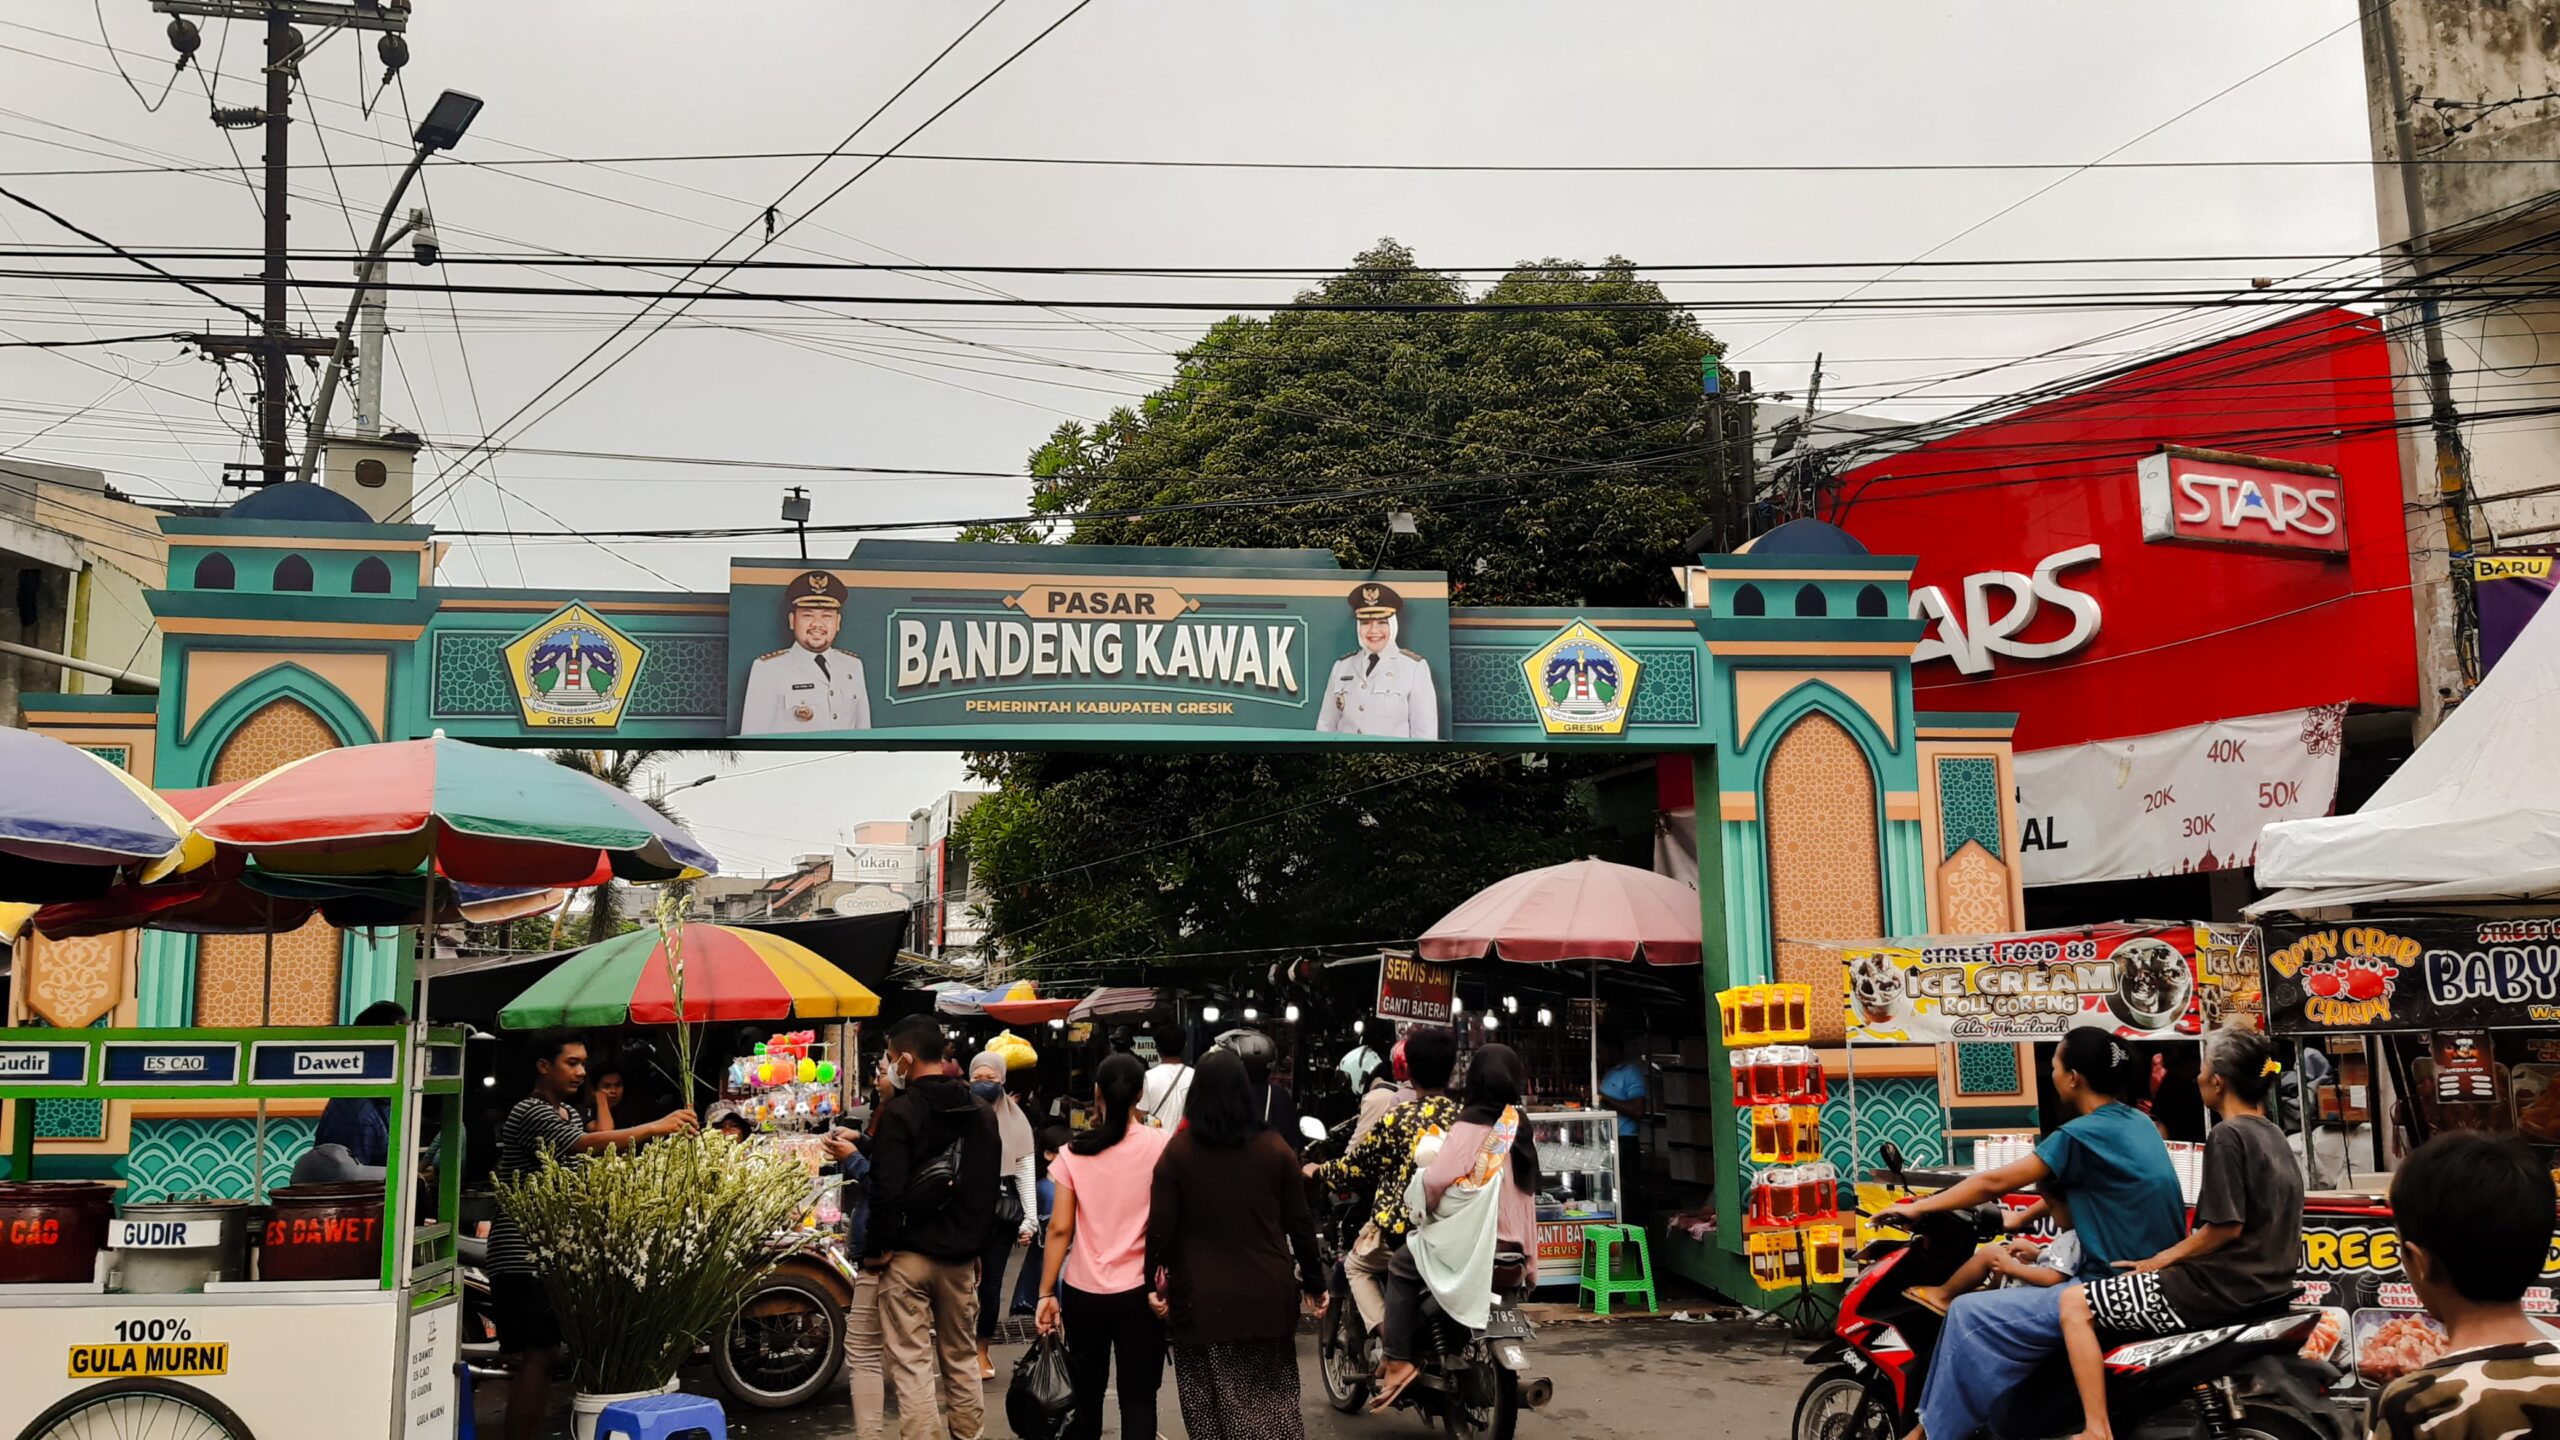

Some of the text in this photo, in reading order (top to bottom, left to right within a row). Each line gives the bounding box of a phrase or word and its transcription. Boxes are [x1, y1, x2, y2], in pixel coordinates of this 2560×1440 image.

[2177, 473, 2337, 535] STARS
[2480, 561, 2543, 576] BARU
[1047, 591, 1156, 615] PASAR
[897, 619, 1299, 693] BANDENG KAWAK
[965, 700, 1234, 715] PEMERINTAH KABUPATEN GRESIK
[547, 716, 596, 725] GRESIK
[1563, 724, 1604, 732] GRESIK
[2207, 739, 2246, 763] 40K
[2144, 780, 2303, 813] 20K 50K
[2183, 813, 2216, 837] 30K
[2477, 919, 2550, 943] STREET
[1921, 941, 2097, 965] STREET FOOD 88
[2206, 948, 2230, 974] ICE
[2269, 927, 2421, 978] BABY CRAB
[1387, 958, 1426, 984] SERVIS
[1905, 961, 2118, 998] ICE CREAM
[2425, 945, 2560, 1006] BABY
[1383, 996, 1449, 1019] GANTI BATERAI
[1941, 994, 2078, 1015] ROLL GORENG
[2305, 995, 2391, 1026] CRISPY
[1952, 1016, 2070, 1037] Ala Thailand
[146, 1057, 202, 1071] ES CAO
[298, 1054, 361, 1071] Dawet
[11, 1218, 60, 1245] CAO
[124, 1223, 187, 1246] GUDIR
[266, 1217, 376, 1247] ES DAWET
[1541, 1245, 1578, 1256] SERVIS
[114, 1318, 192, 1342] 100%
[72, 1346, 224, 1373] GULA MURNI
[412, 1347, 434, 1365] ES DAWET
[413, 1366, 430, 1381] ES CAO
[411, 1382, 432, 1400] ES GUDIR
